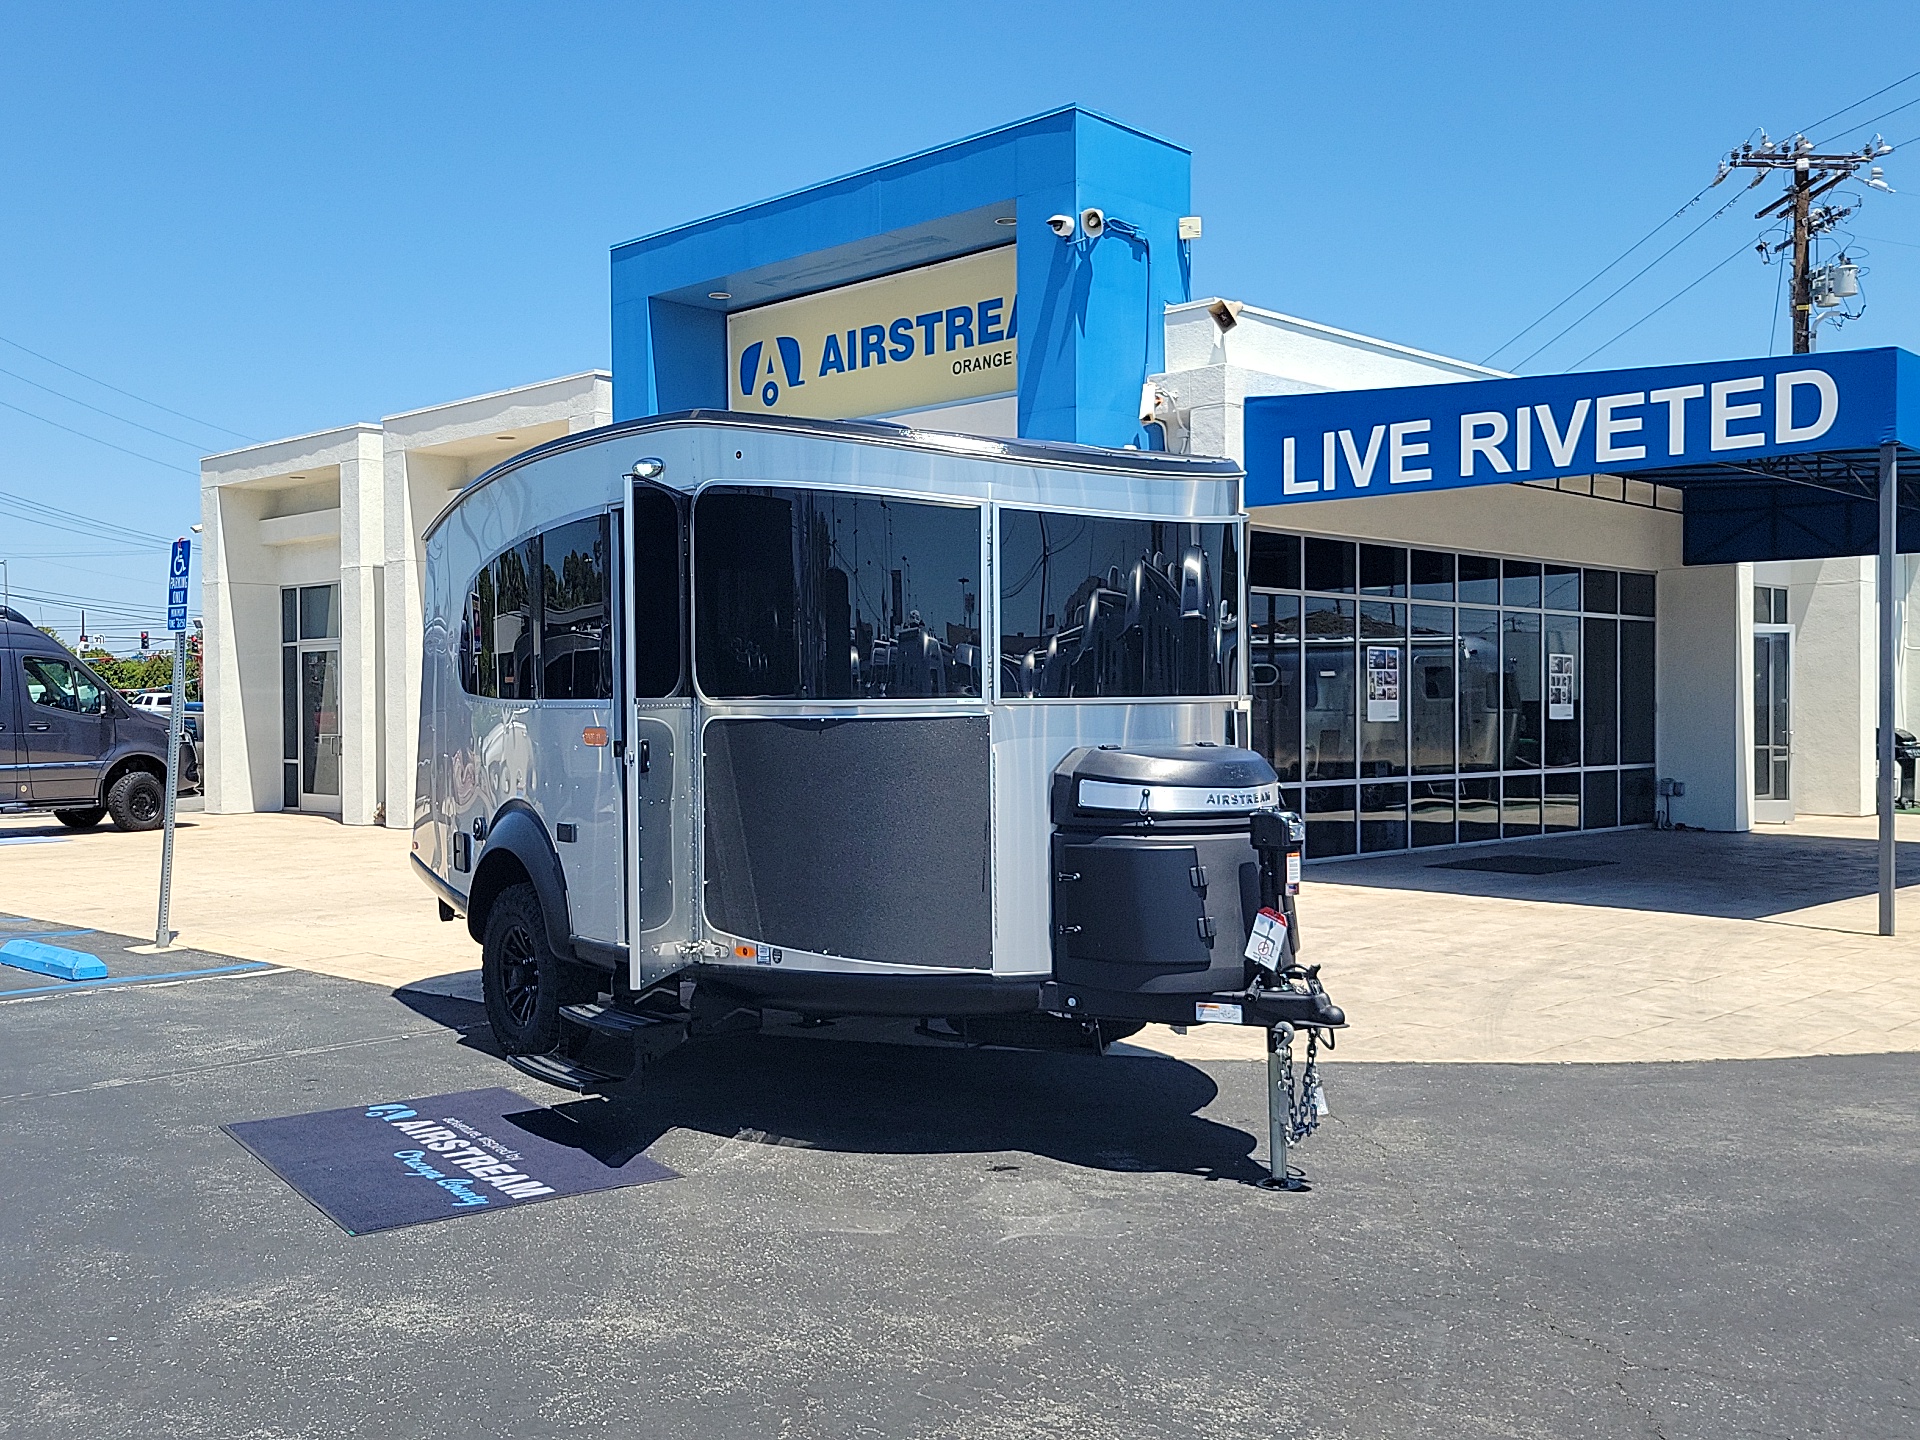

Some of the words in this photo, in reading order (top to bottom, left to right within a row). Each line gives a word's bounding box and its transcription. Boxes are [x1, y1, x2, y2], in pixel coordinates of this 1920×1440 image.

[818, 294, 1018, 377] AIRSTRE
[952, 350, 1013, 375] ORANGE
[1283, 419, 1432, 495] LIVE
[1460, 369, 1839, 477] RIVETED
[170, 576, 187, 589] PARKING
[172, 590, 184, 603] ONLY
[1206, 791, 1271, 805] AIRSTREAM
[391, 1120, 556, 1199] AIRSTREAM
[394, 1150, 445, 1179] Orange
[437, 1179, 489, 1206] County
